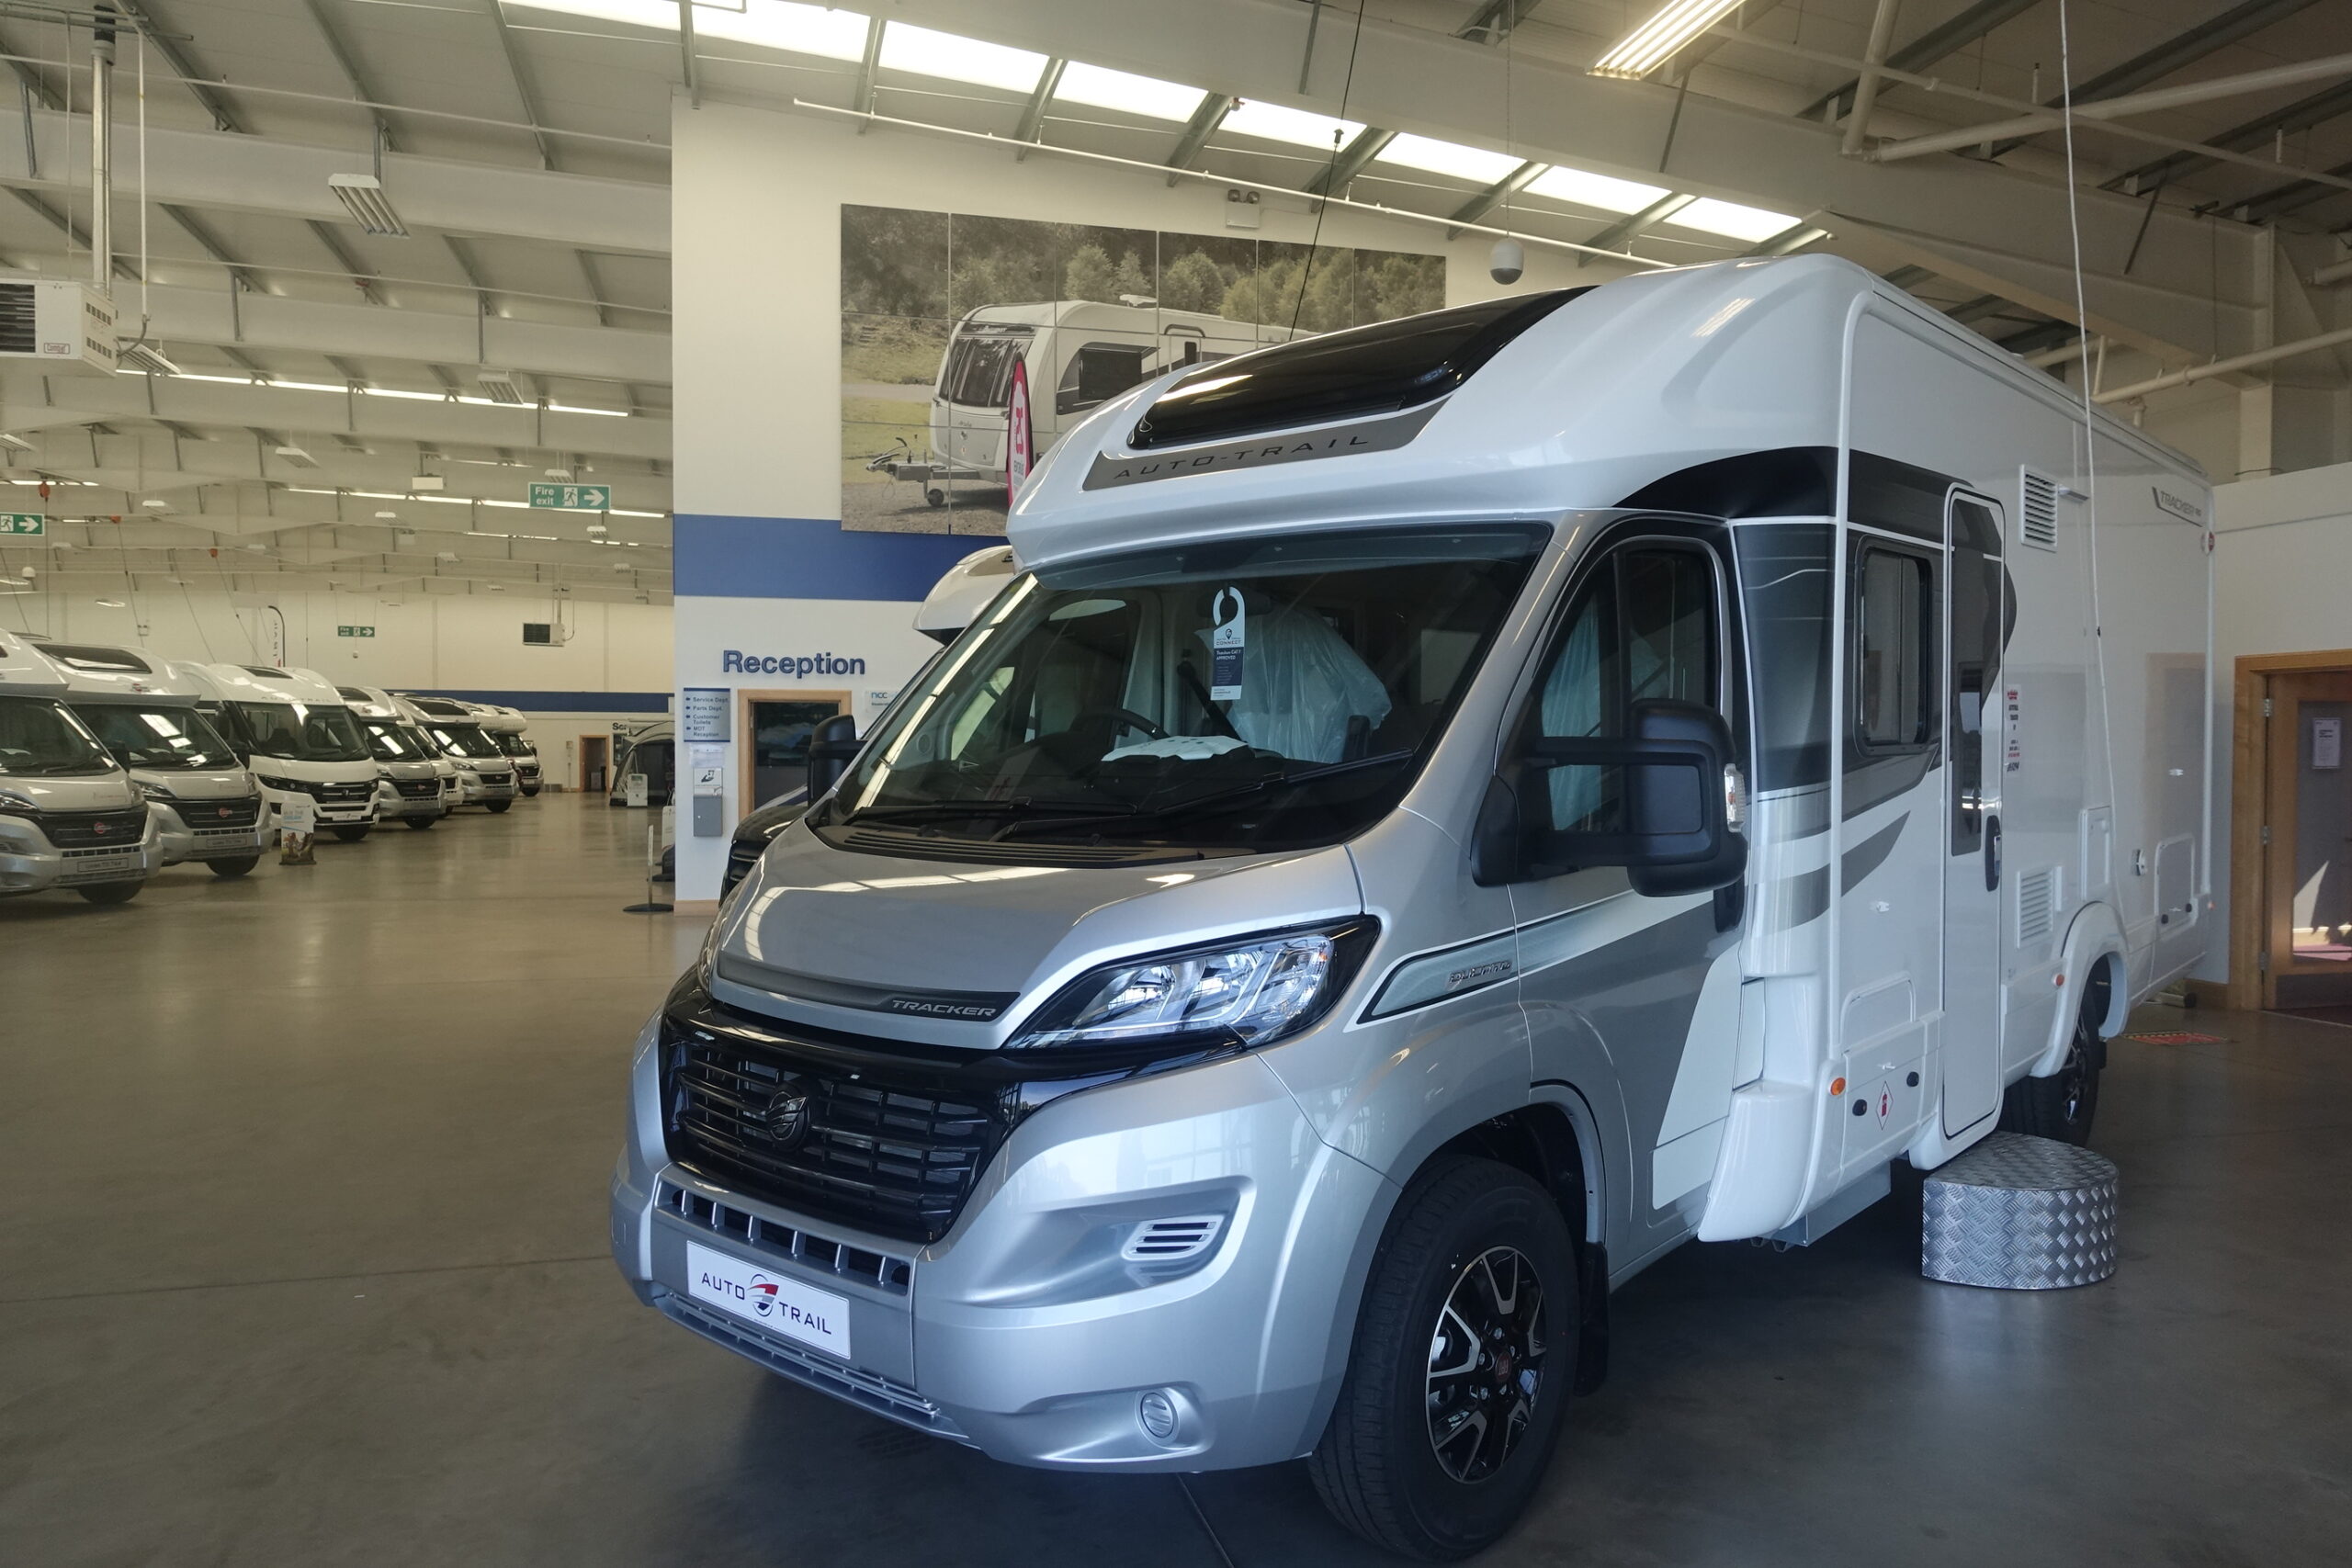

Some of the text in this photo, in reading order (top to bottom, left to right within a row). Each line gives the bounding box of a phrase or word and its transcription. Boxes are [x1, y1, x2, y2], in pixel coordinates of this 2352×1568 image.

[1113, 435, 1369, 479] AUTO-TRAIL
[535, 486, 555, 496] Fire
[536, 496, 554, 505] exit
[722, 649, 865, 680] Reception
[891, 998, 997, 1017] TRACKER
[701, 1271, 832, 1335] AUTO TRAIL
